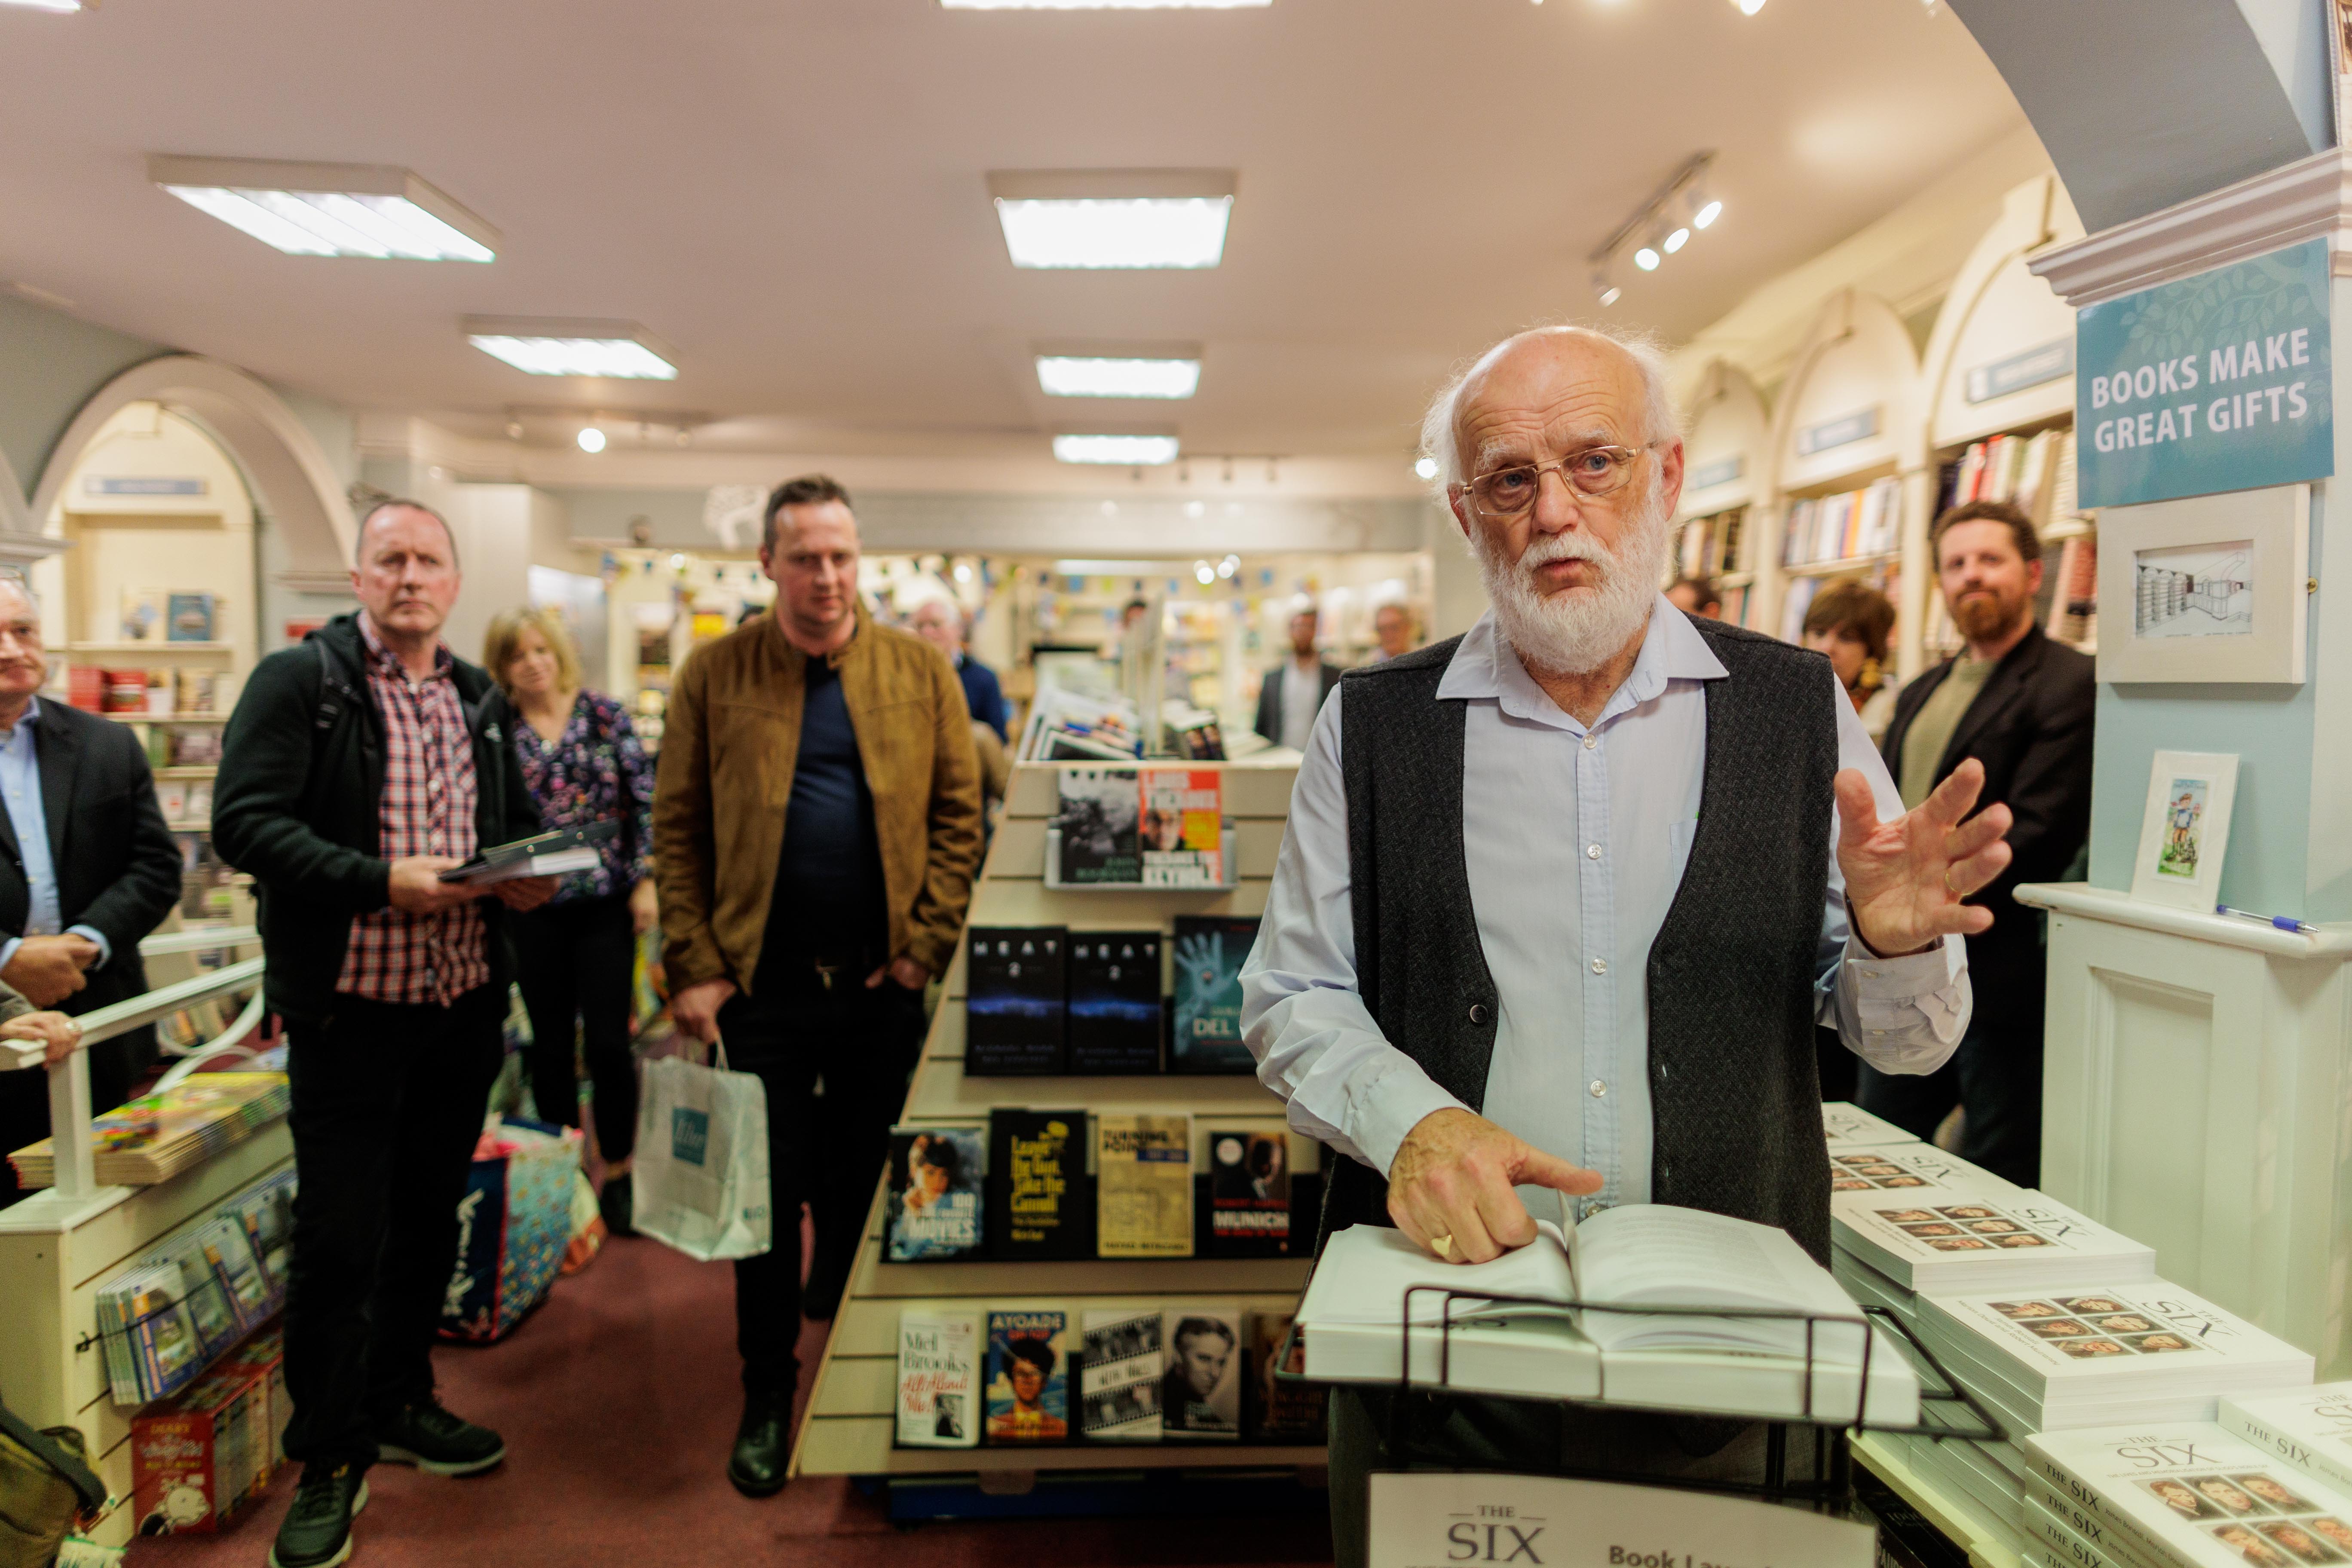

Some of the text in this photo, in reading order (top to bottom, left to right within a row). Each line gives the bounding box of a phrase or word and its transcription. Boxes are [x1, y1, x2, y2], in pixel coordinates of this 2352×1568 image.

[2092, 355, 2198, 410] BOOKS
[2209, 328, 2310, 384] MAKE
[2094, 382, 2308, 453] GREAT GIFTS
[973, 940, 1057, 956] HEAT
[1075, 944, 1156, 959] HEAT
[1213, 1210, 1289, 1230] MUNICH
[2012, 1209, 2089, 1237] SIX
[991, 1314, 1062, 1330] AYOADE
[2141, 1301, 2233, 1338] SIX
[2198, 1309, 2228, 1324] THE
[903, 1351, 969, 1372] Brooks
[2123, 1436, 2162, 1444] THE
[2245, 1421, 2271, 1444] THE
[2277, 1437, 2311, 1468] SIX
[2318, 1464, 2338, 1479] James
[2116, 1443, 2223, 1468] SIX
[2046, 1462, 2066, 1485] THE
[2071, 1480, 2099, 1512] SIX
[1477, 1505, 1516, 1517] THE
[2047, 1493, 2068, 1517] THE
[2074, 1512, 2102, 1544] SIX
[2108, 1541, 2125, 1557] James
[1447, 1522, 1546, 1564] SIX
[2046, 1523, 2101, 1568] THE SIX
[1609, 1545, 1676, 1568] Book
[2046, 1552, 2067, 1568] TH
